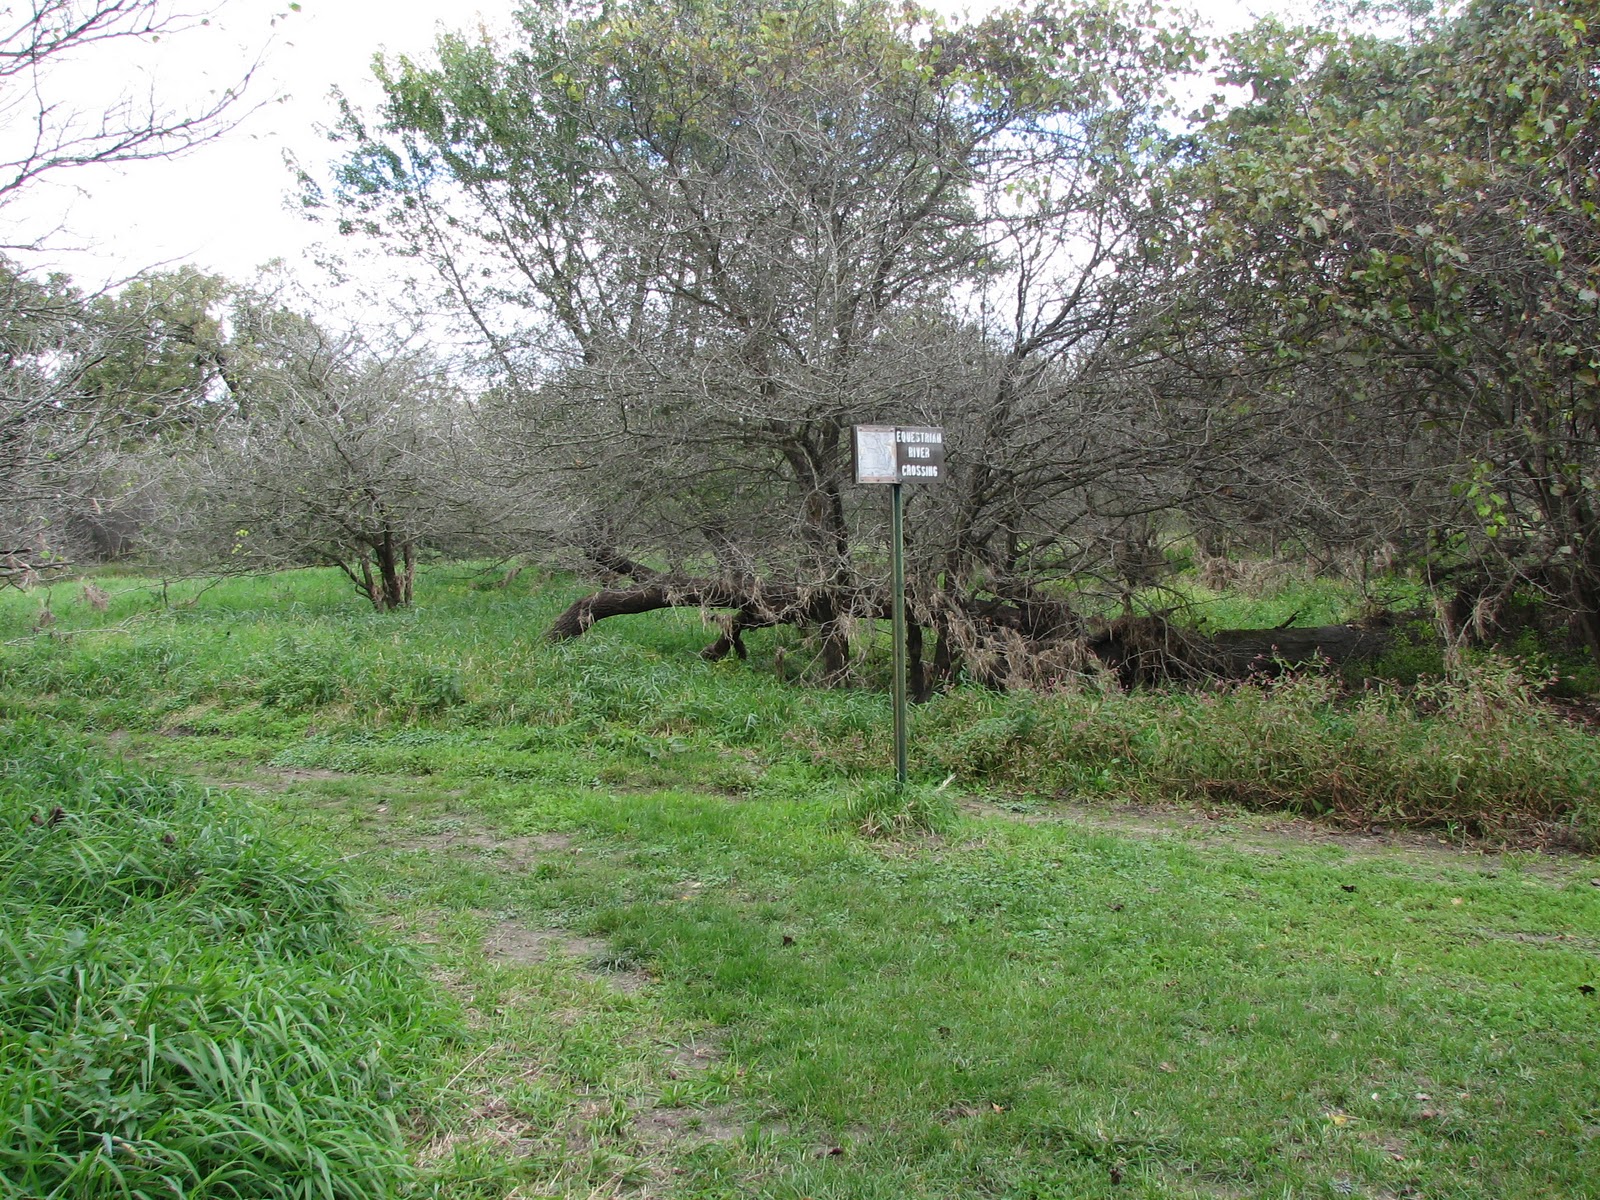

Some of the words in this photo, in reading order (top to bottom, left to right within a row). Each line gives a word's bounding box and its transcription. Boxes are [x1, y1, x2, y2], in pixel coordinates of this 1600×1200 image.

[896, 430, 942, 444] EQUESTRIAN
[908, 446, 930, 459] RIVER
[901, 464, 938, 477] CROSSING
